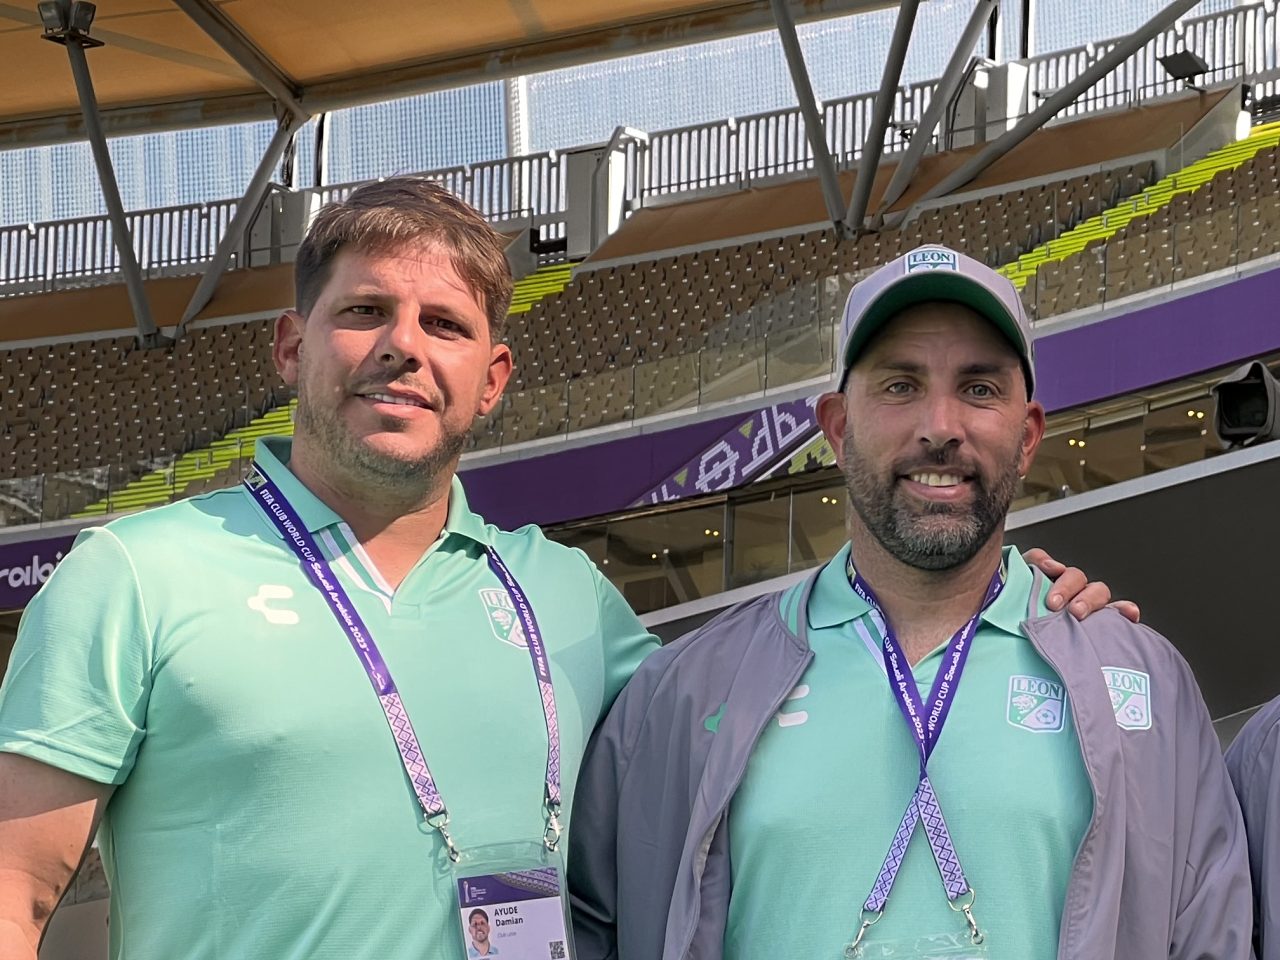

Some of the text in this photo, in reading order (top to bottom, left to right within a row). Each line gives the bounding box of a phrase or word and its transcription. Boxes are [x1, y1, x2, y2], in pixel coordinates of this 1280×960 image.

[913, 252, 950, 262] LEON
[260, 489, 274, 505] FIFA
[271, 503, 287, 522] CLUB
[283, 517, 304, 547] WORLD
[301, 547, 315, 562] CUP
[311, 562, 334, 594] Saudi
[329, 589, 353, 626] Arabia
[520, 604, 535, 632] WORLD
[884, 637, 894, 652] CUP
[890, 650, 904, 682] Saudi
[898, 682, 916, 716] Arabia
[928, 699, 944, 732] WORLD
[938, 682, 950, 702] CUP
[944, 652, 960, 682] Saudi
[1016, 679, 1060, 698] LEON
[494, 906, 518, 917] AYUDE
[495, 917, 524, 927] Damian
